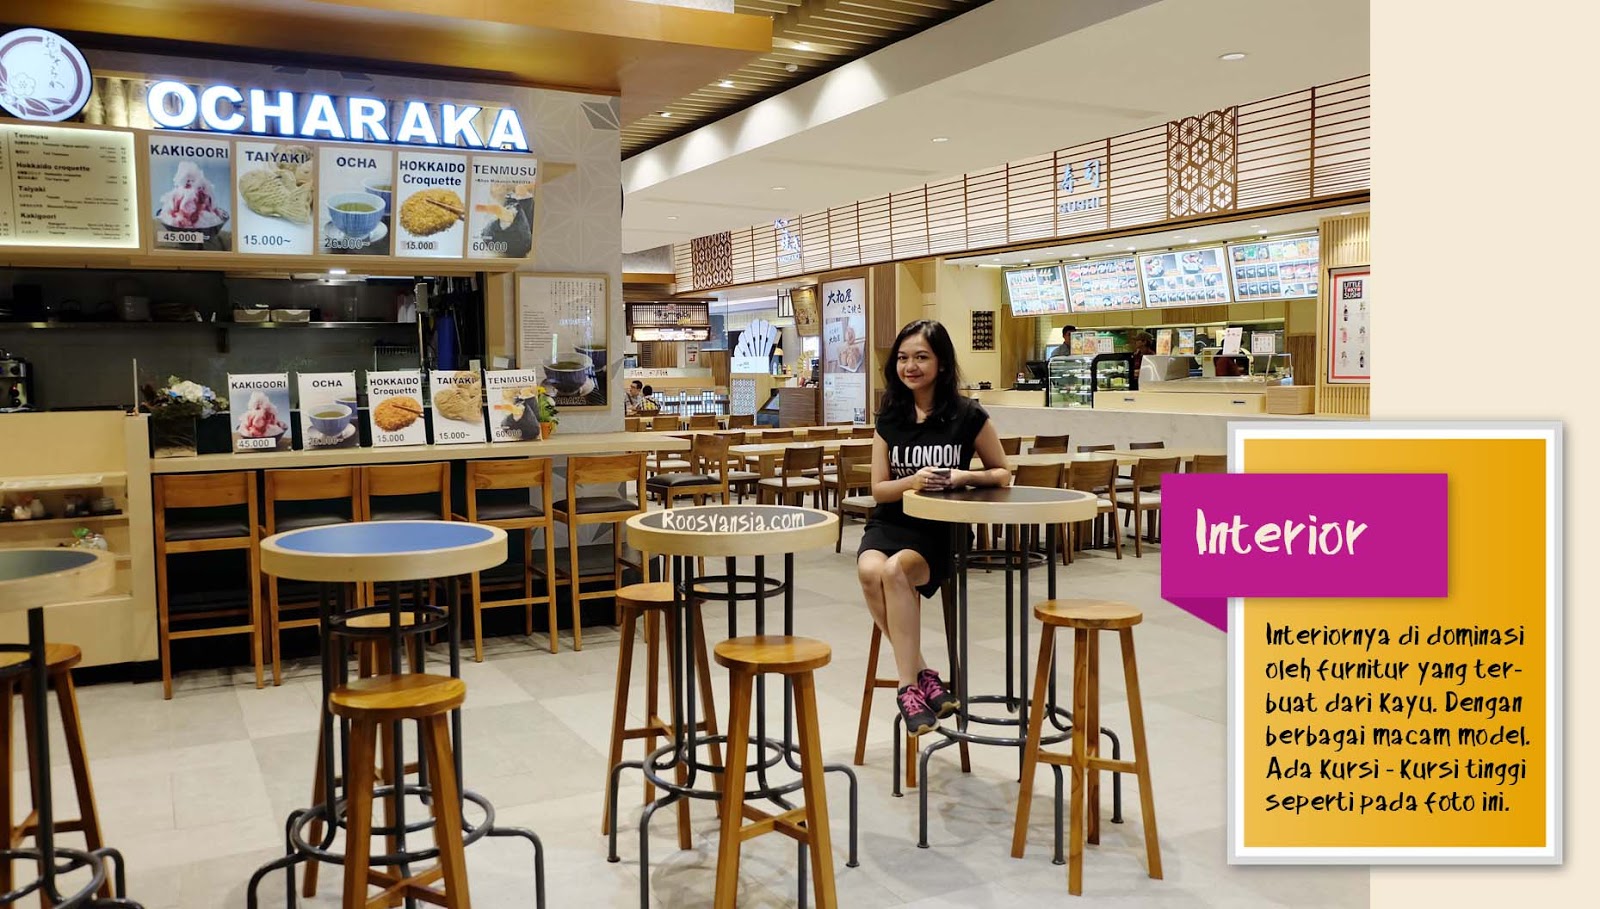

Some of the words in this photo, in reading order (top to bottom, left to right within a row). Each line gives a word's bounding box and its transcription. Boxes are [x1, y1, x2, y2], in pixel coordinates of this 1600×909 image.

[148, 81, 529, 150] OCHARAKA
[150, 144, 229, 159] KAKIGOORI
[245, 151, 305, 164] TAIYAKI
[336, 156, 377, 169] OCHA
[399, 160, 466, 173] HOKKAIDO
[473, 165, 536, 176] TENMUSU
[403, 174, 462, 188] Croquette
[163, 233, 197, 242] 45.000
[406, 241, 434, 250] 15.000
[312, 380, 343, 388] OCHA
[370, 377, 419, 386] HOKKAIDO
[488, 376, 535, 384] TENMUSU
[231, 381, 286, 389] KAKIGOORI
[373, 387, 418, 396] Croquette
[377, 434, 405, 443] 15.000
[239, 439, 270, 448] 45.000
